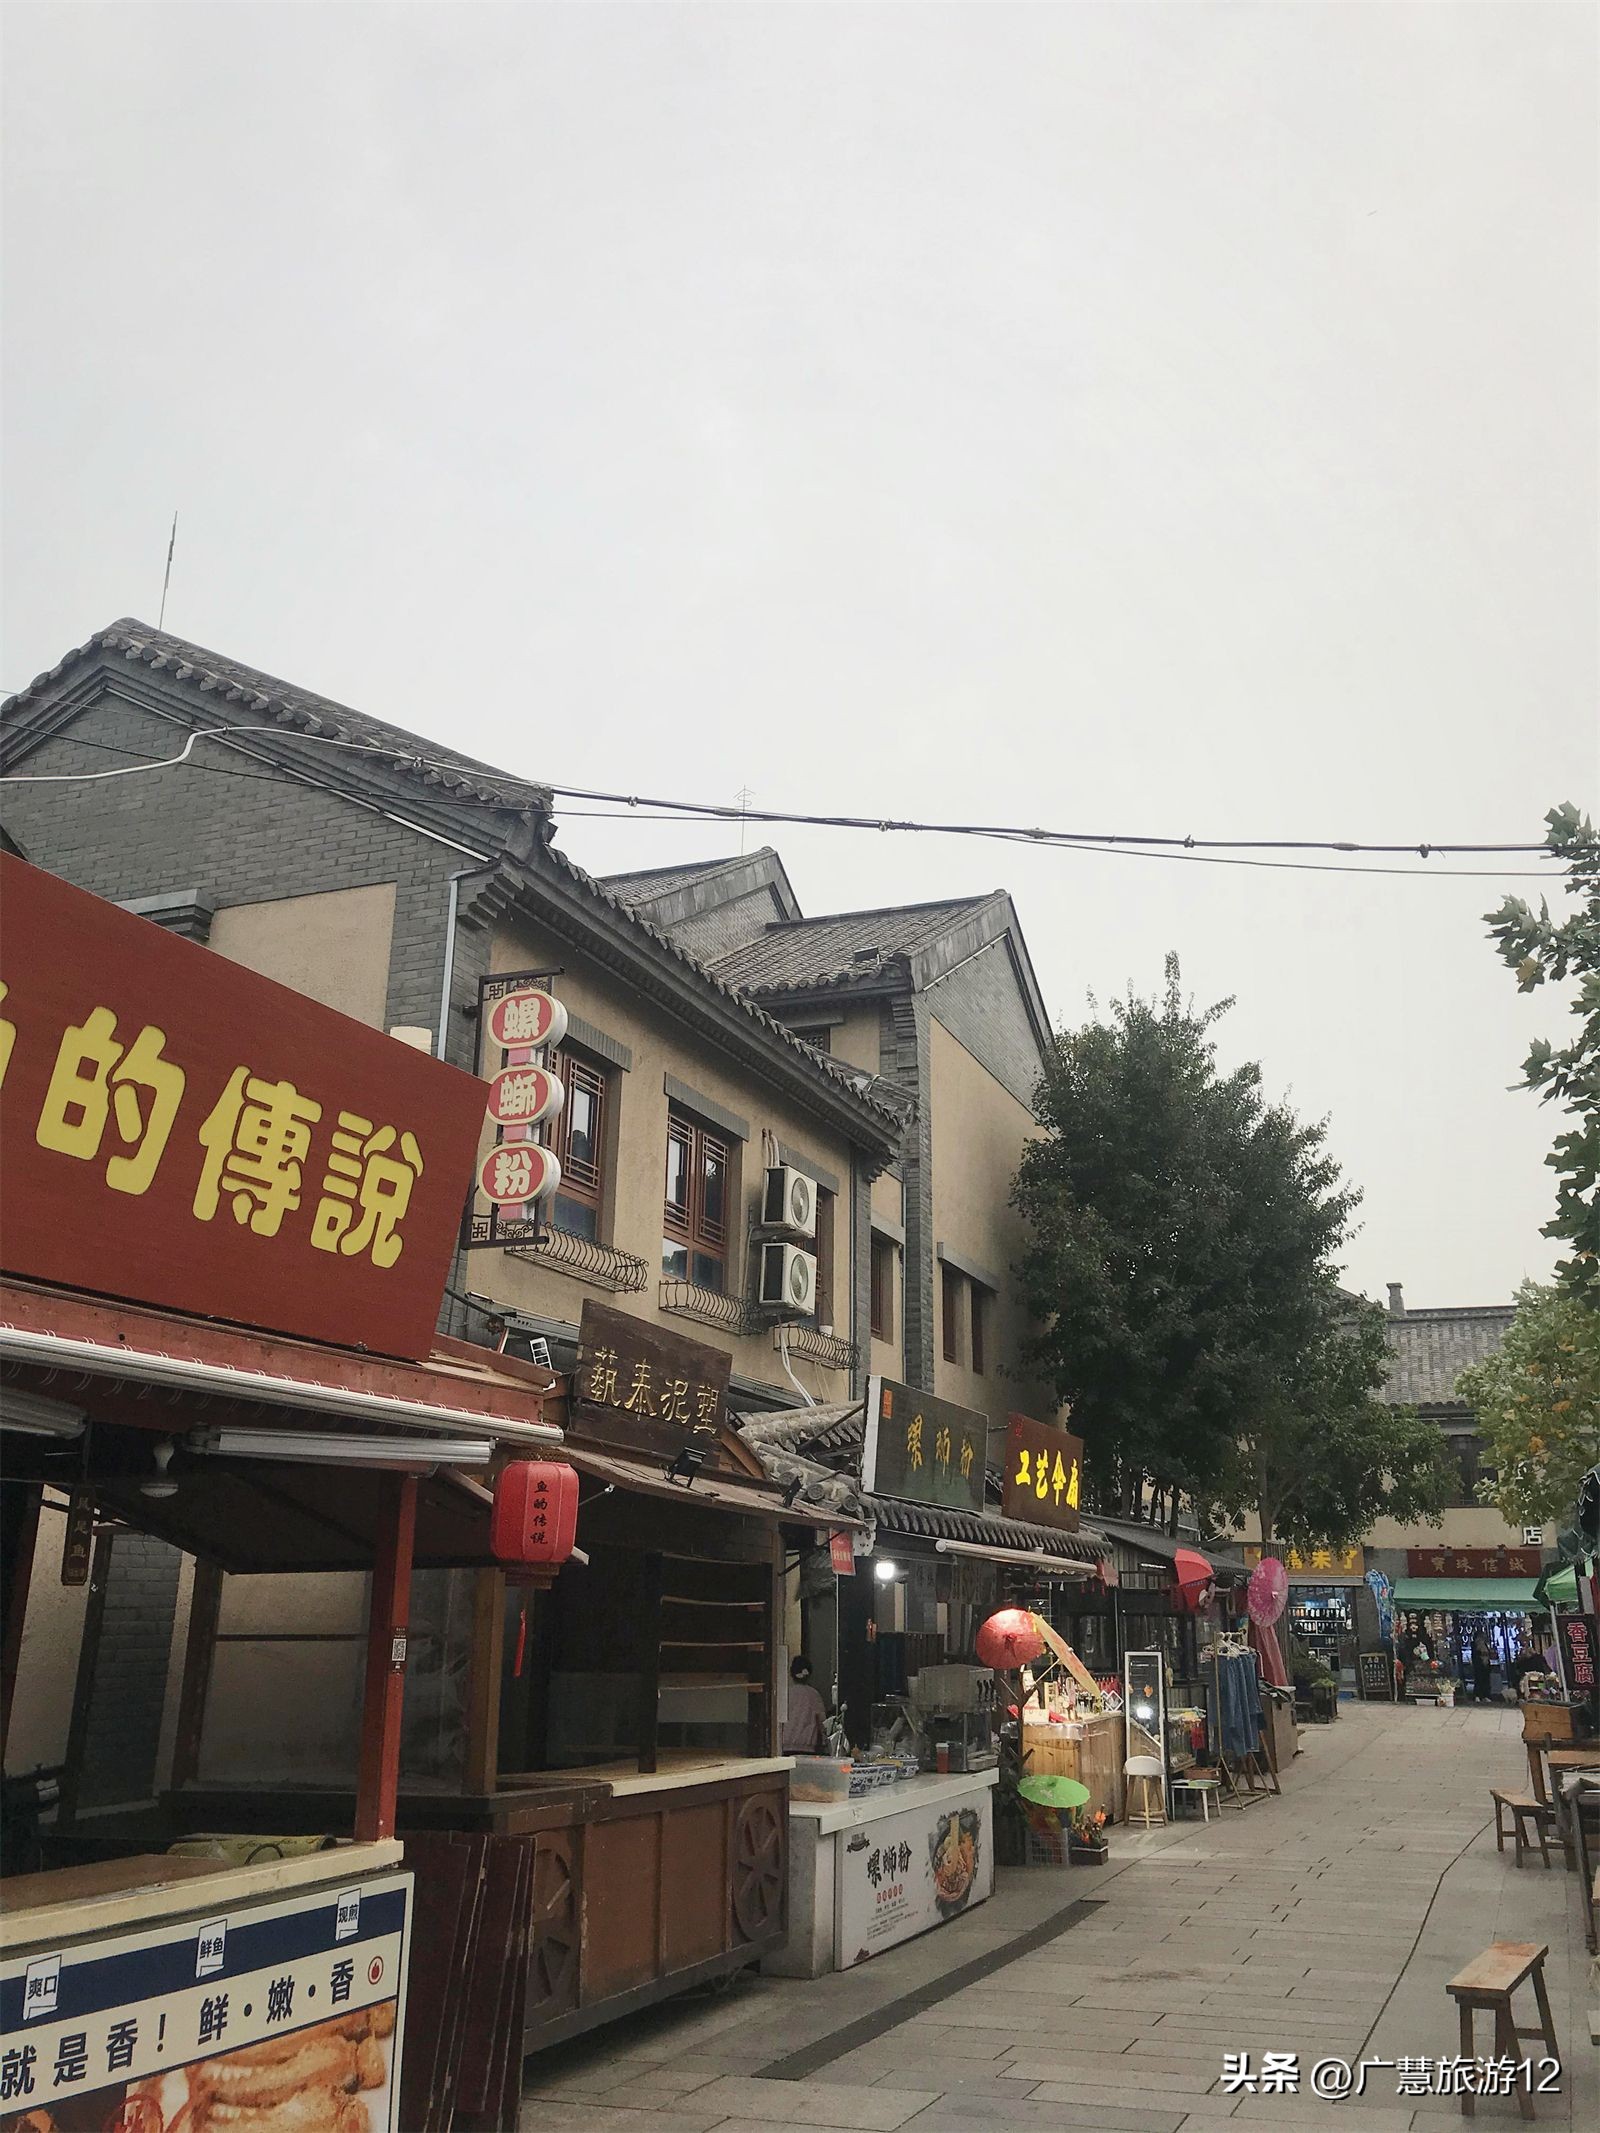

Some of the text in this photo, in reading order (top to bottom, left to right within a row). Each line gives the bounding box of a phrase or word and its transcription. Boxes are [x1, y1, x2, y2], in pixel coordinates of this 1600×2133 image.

[0, 979, 425, 1269] 的傳說
[1567, 1622, 1594, 1683] 香豆腐
[337, 1903, 360, 1925] 现煎
[199, 1936, 225, 1959] 鲜鱼
[27, 1973, 58, 1998] 爽口
